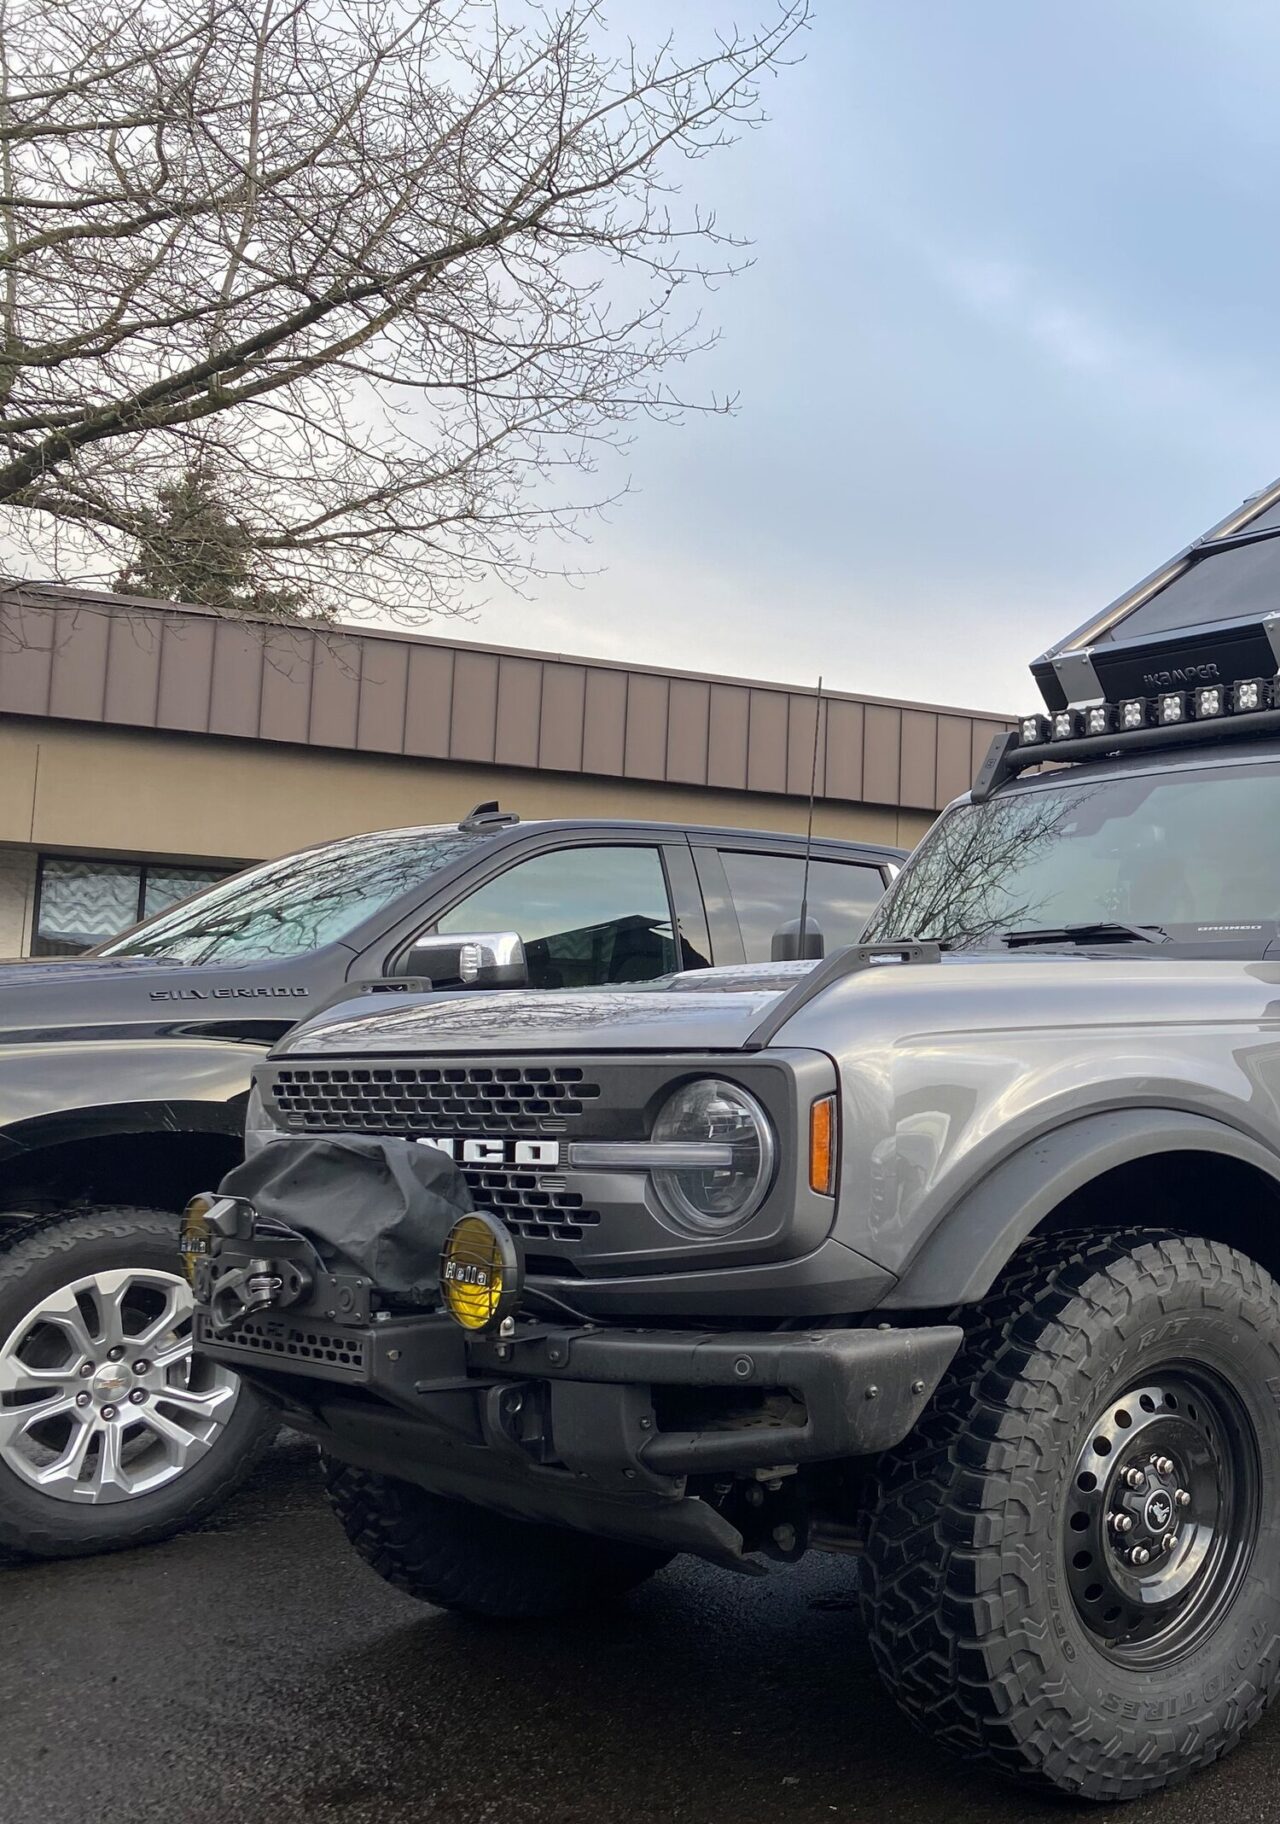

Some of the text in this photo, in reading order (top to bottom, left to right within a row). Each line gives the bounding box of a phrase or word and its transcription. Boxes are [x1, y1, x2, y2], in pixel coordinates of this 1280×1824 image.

[150, 986, 309, 1001] SILVERADO
[445, 1262, 487, 1285] Hella
[1101, 1690, 1200, 1722] TIRES
